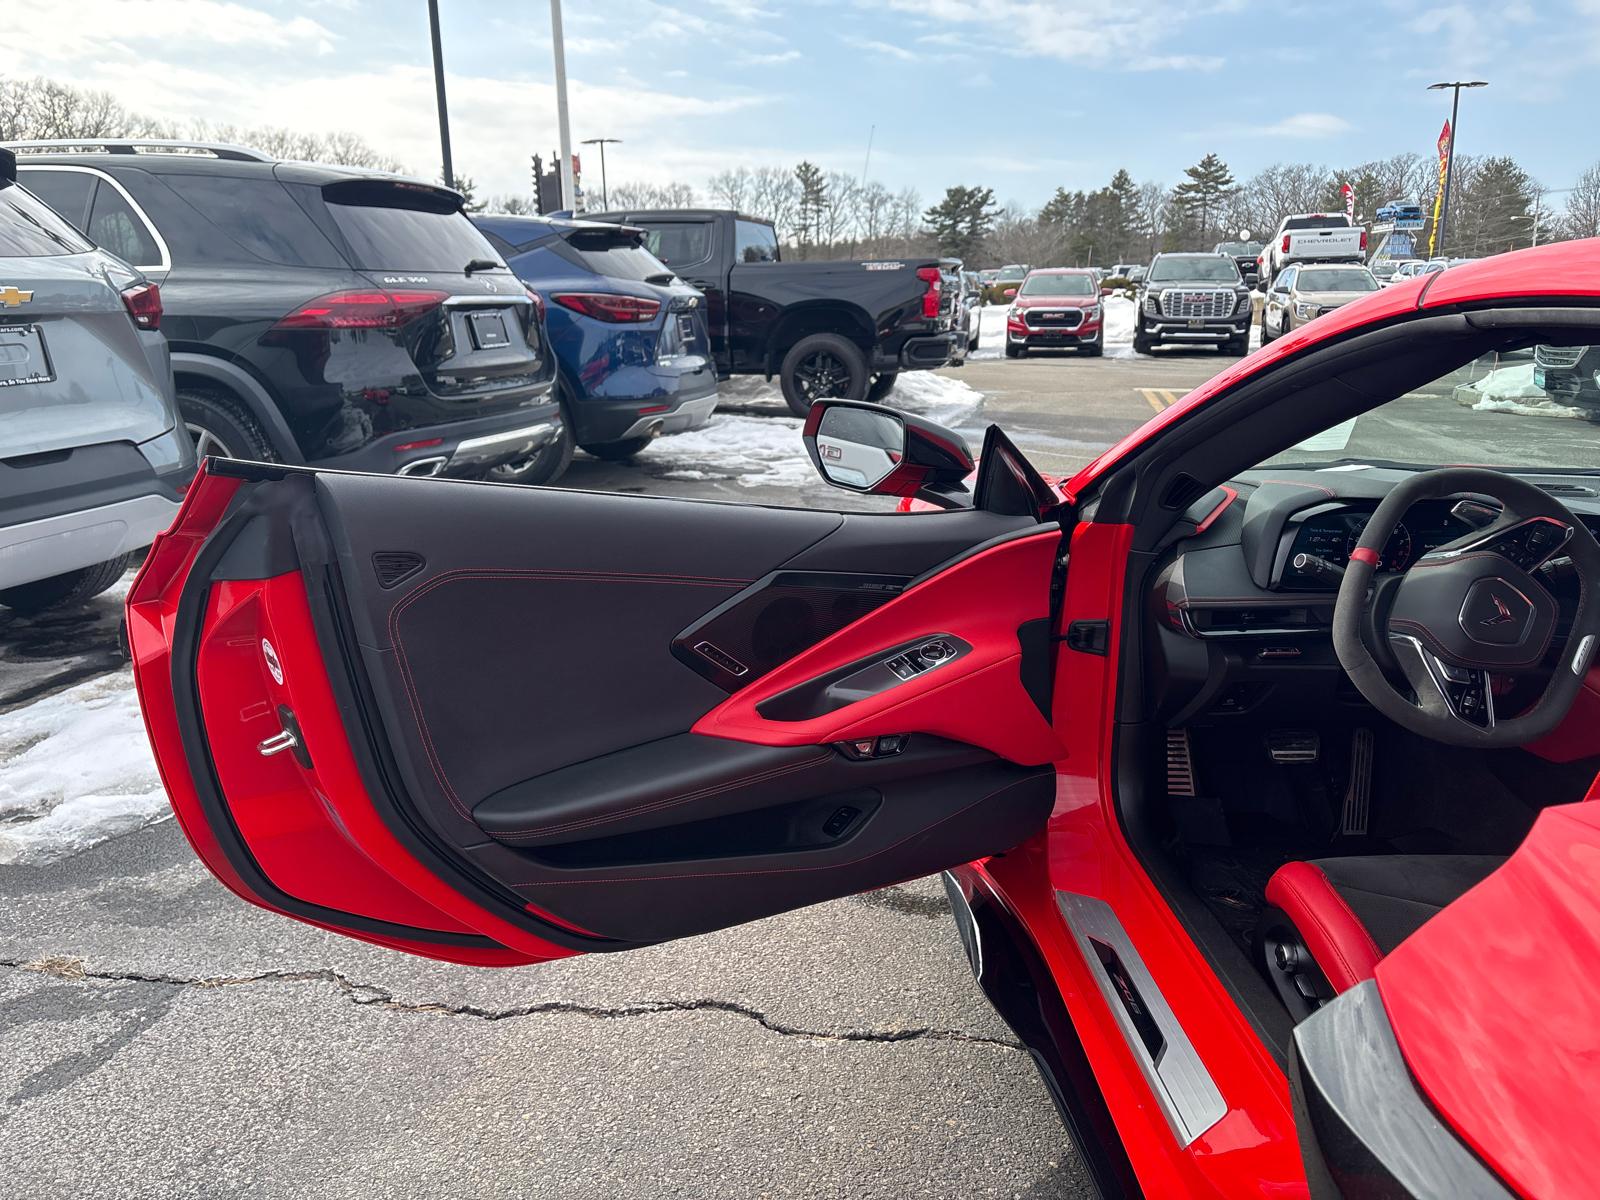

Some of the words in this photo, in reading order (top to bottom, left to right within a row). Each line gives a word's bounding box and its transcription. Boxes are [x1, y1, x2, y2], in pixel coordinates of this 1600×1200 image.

[1390, 234, 1405, 245] SHOP
[1384, 244, 1411, 254] COMPARE
[1376, 560, 1383, 569] P
[1577, 640, 1589, 668] Z06
[1112, 972, 1142, 1015] Z06
